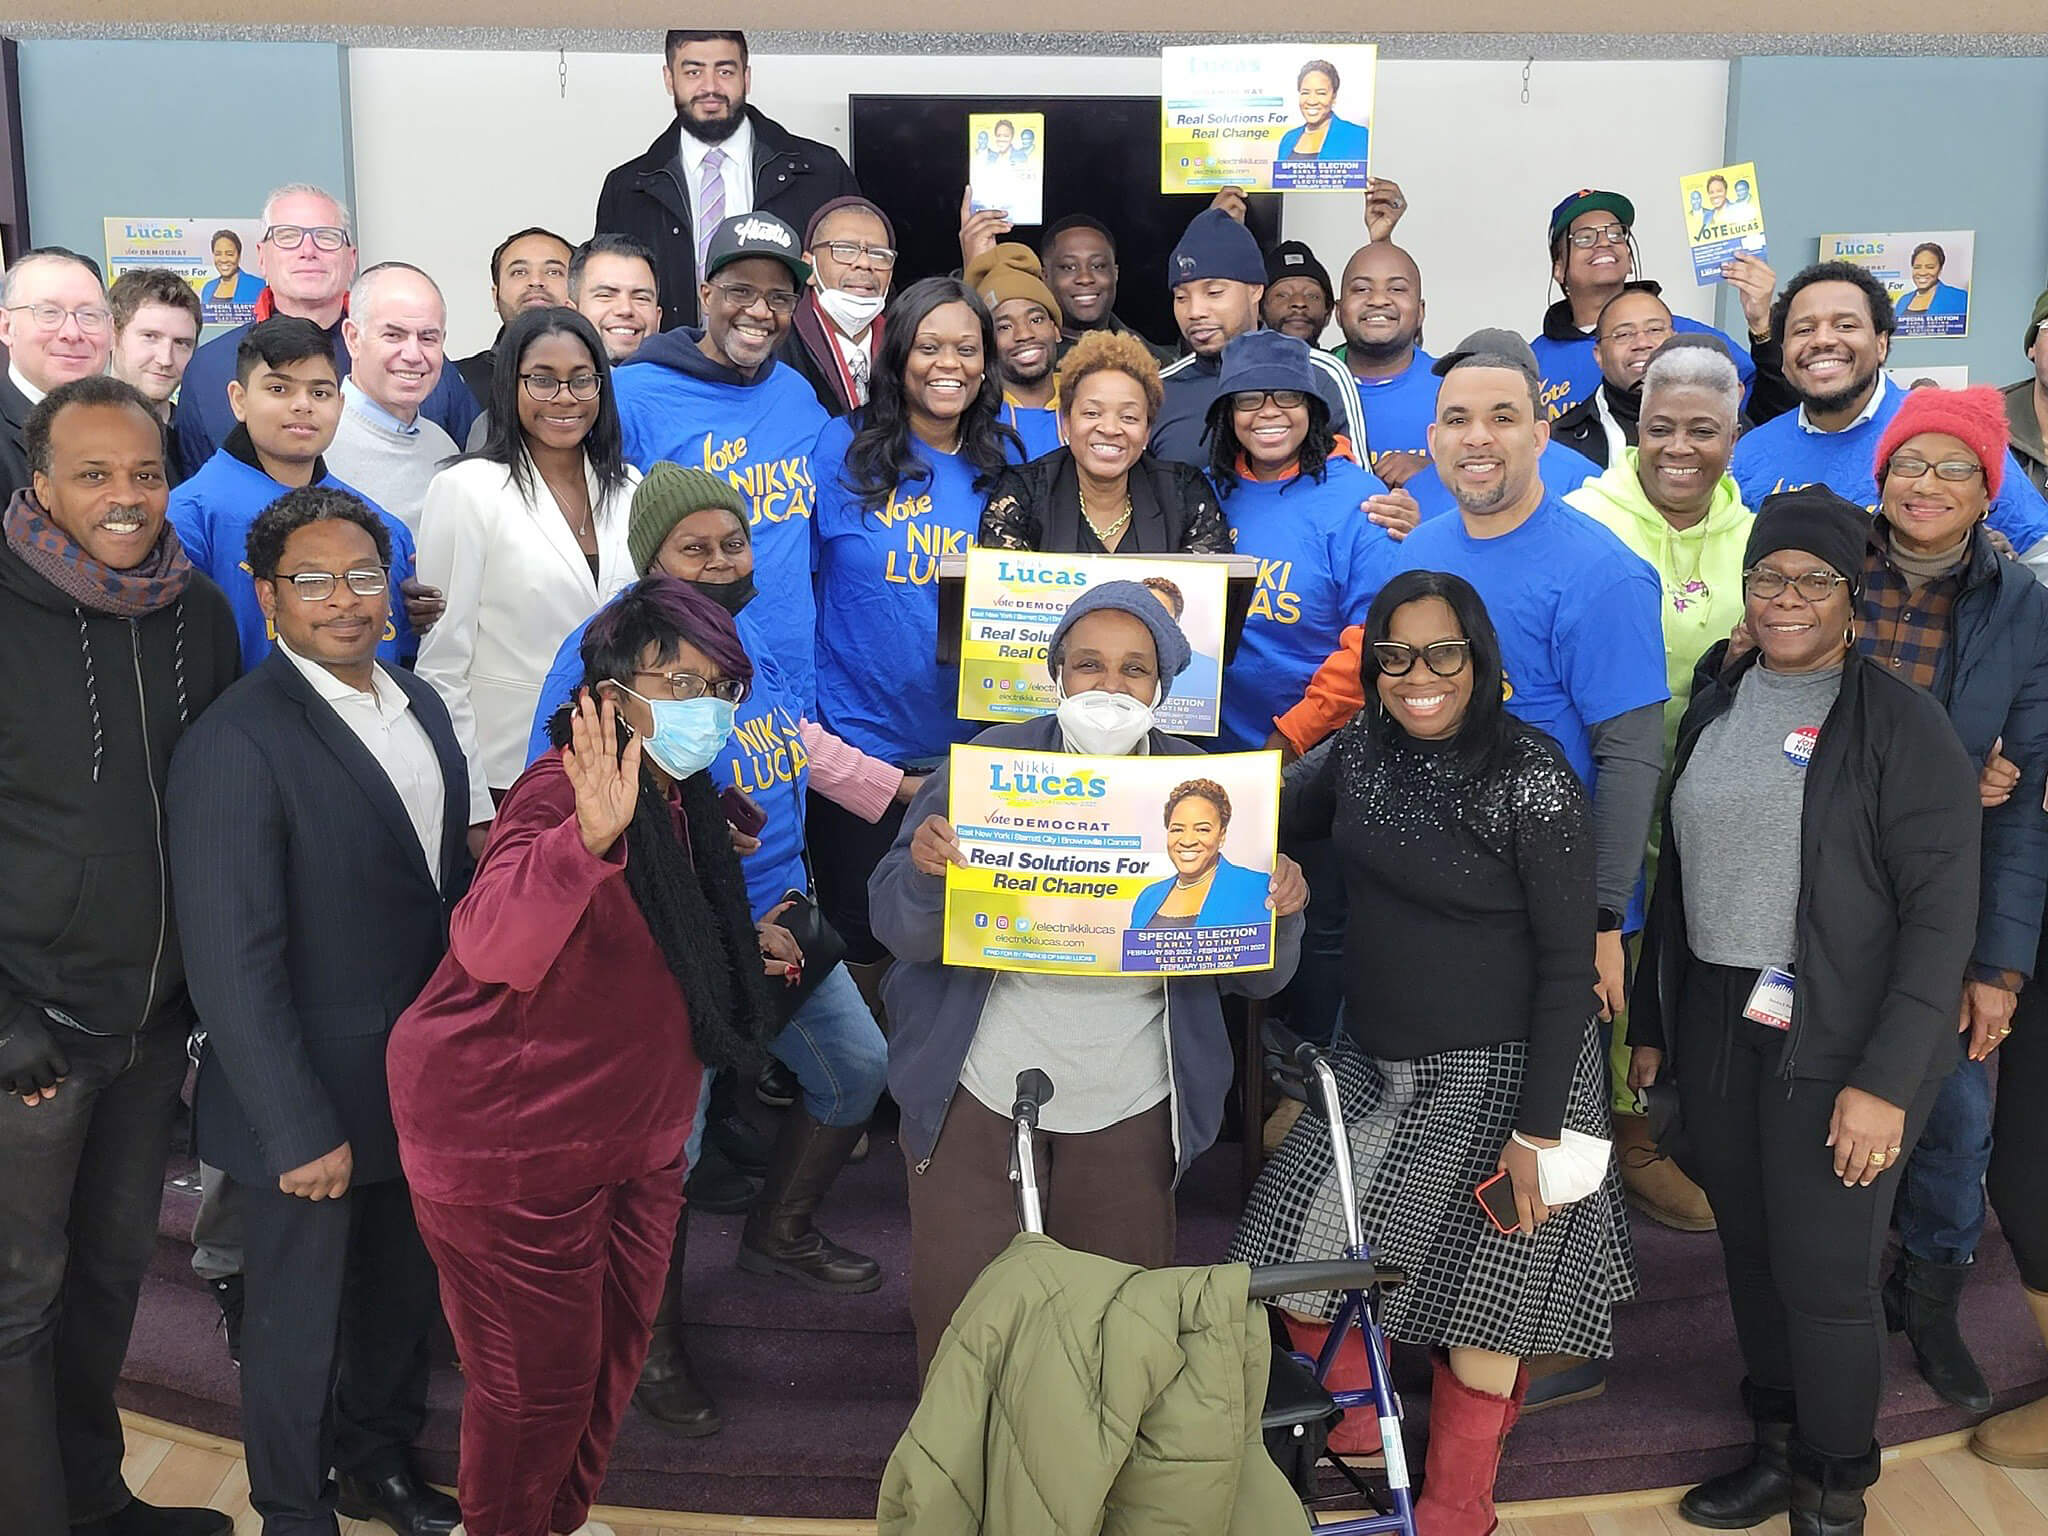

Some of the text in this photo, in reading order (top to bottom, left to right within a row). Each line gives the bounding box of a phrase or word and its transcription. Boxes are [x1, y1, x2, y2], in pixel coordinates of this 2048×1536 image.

[1177, 112, 1288, 125] Real Solutions For
[1192, 127, 1270, 142] Real Change
[125, 224, 183, 239] Lucas
[1730, 222, 1759, 235] LUCAS
[1835, 241, 1885, 256] Lucas
[191, 267, 207, 277] For
[1887, 281, 1904, 290] For
[694, 432, 748, 475] Vote
[874, 487, 933, 528] Vote
[998, 561, 1087, 586] Lucas
[980, 626, 1016, 640] Real
[999, 645, 1033, 659] Real
[1013, 760, 1055, 774] Nikki
[990, 764, 1106, 798] Lucas
[984, 808, 1111, 832] Vote DEMOCRAT
[957, 828, 974, 837] East
[975, 829, 992, 838] New
[993, 830, 1010, 840] York
[1041, 834, 1057, 845] City
[970, 848, 1150, 874] Real Solutions For
[994, 873, 1118, 898] Real Change
[1032, 921, 1116, 935] /electnikkilucas
[1138, 927, 1257, 942] SPECIAL ELECTION
[995, 935, 1085, 948] electnikkilucas.com
[1156, 939, 1240, 949] EARLY VOTING
[1198, 946, 1233, 954] FEBRUARY
[1250, 943, 1266, 951] 2022
[1155, 953, 1240, 963] ELECTION DAY
[1159, 963, 1197, 971] FEBRUARY
